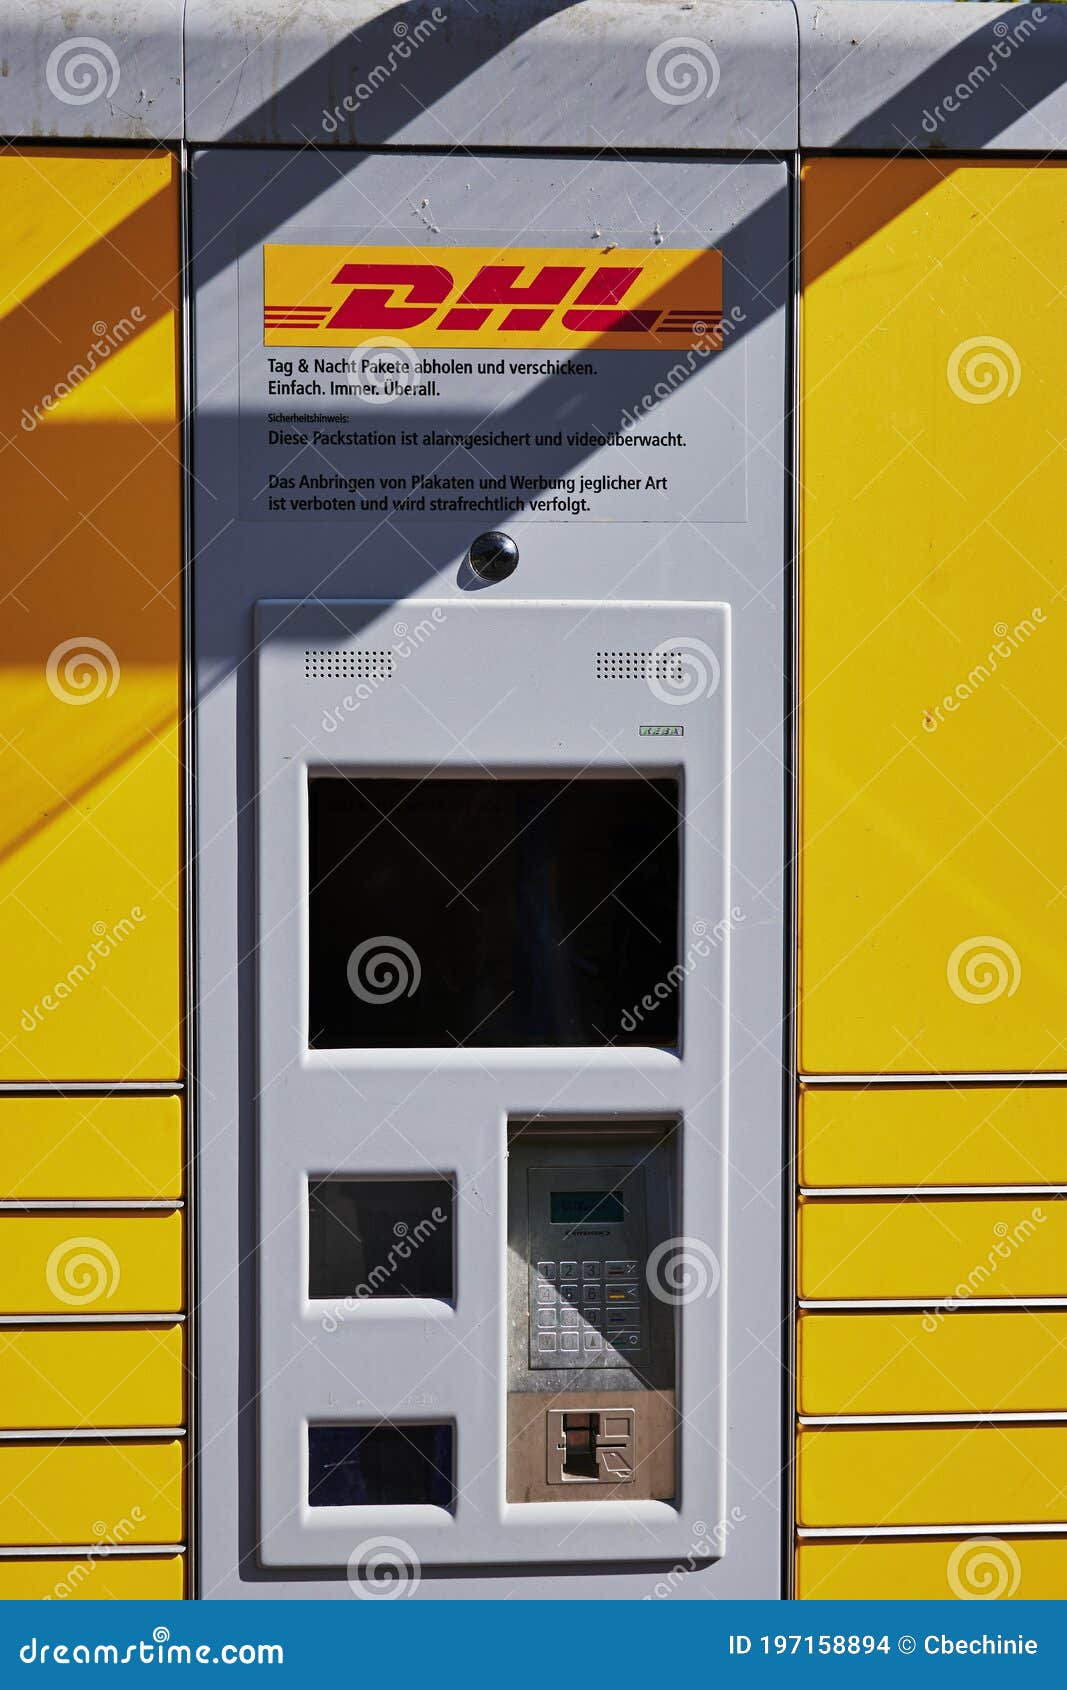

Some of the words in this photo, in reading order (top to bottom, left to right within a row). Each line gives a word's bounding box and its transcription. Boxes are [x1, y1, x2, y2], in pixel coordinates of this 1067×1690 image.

[325, 264, 665, 332] DHL
[268, 359, 293, 377] Tag
[298, 359, 310, 373] &
[314, 359, 356, 374] Nacht
[361, 360, 409, 374] Pakete
[415, 359, 473, 374] abholen
[478, 360, 505, 375] und
[510, 360, 597, 376] verschicken.
[268, 380, 325, 396] Einfach.
[330, 381, 379, 396] Immer.
[384, 378, 440, 396] Überall.
[267, 413, 349, 424] Sicherheitshinweis:
[269, 431, 308, 446] Diese
[313, 431, 396, 446] Packstation
[401, 432, 418, 446] ist
[423, 431, 530, 449] alarmgesichert
[535, 432, 562, 447] und
[567, 432, 686, 447] videoüberwacht.
[269, 475, 295, 489] Das
[299, 474, 375, 493] Anbringen
[380, 479, 406, 490] von
[411, 475, 474, 490] Plakaten
[479, 475, 506, 490] und
[510, 475, 575, 493] Werbung
[579, 476, 640, 494] jeglicher
[645, 476, 668, 490] Art
[269, 497, 286, 512] ist
[291, 496, 355, 512] verboten
[360, 496, 388, 512] und
[392, 496, 424, 512] wird
[430, 496, 525, 512] strafrechtlich
[529, 497, 590, 515] verfolgt.
